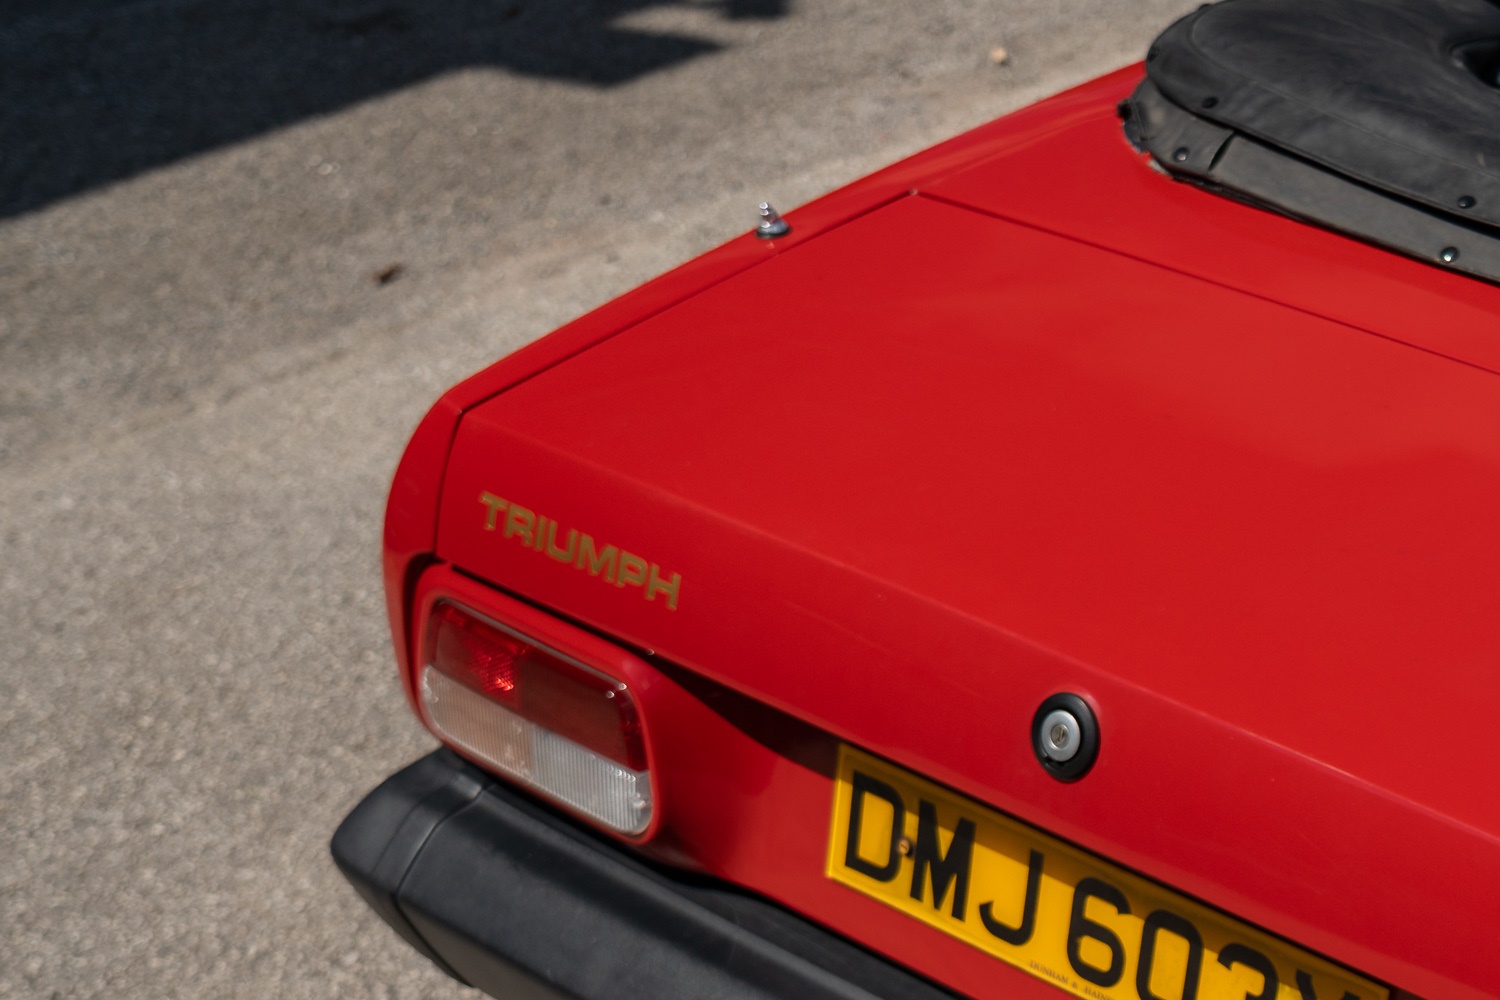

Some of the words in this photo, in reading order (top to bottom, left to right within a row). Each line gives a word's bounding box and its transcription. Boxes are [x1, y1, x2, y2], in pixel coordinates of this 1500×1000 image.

[479, 490, 682, 611] TRIUMPH
[845, 771, 1044, 946] DMJ
[1029, 960, 1068, 983] DUNHAM
